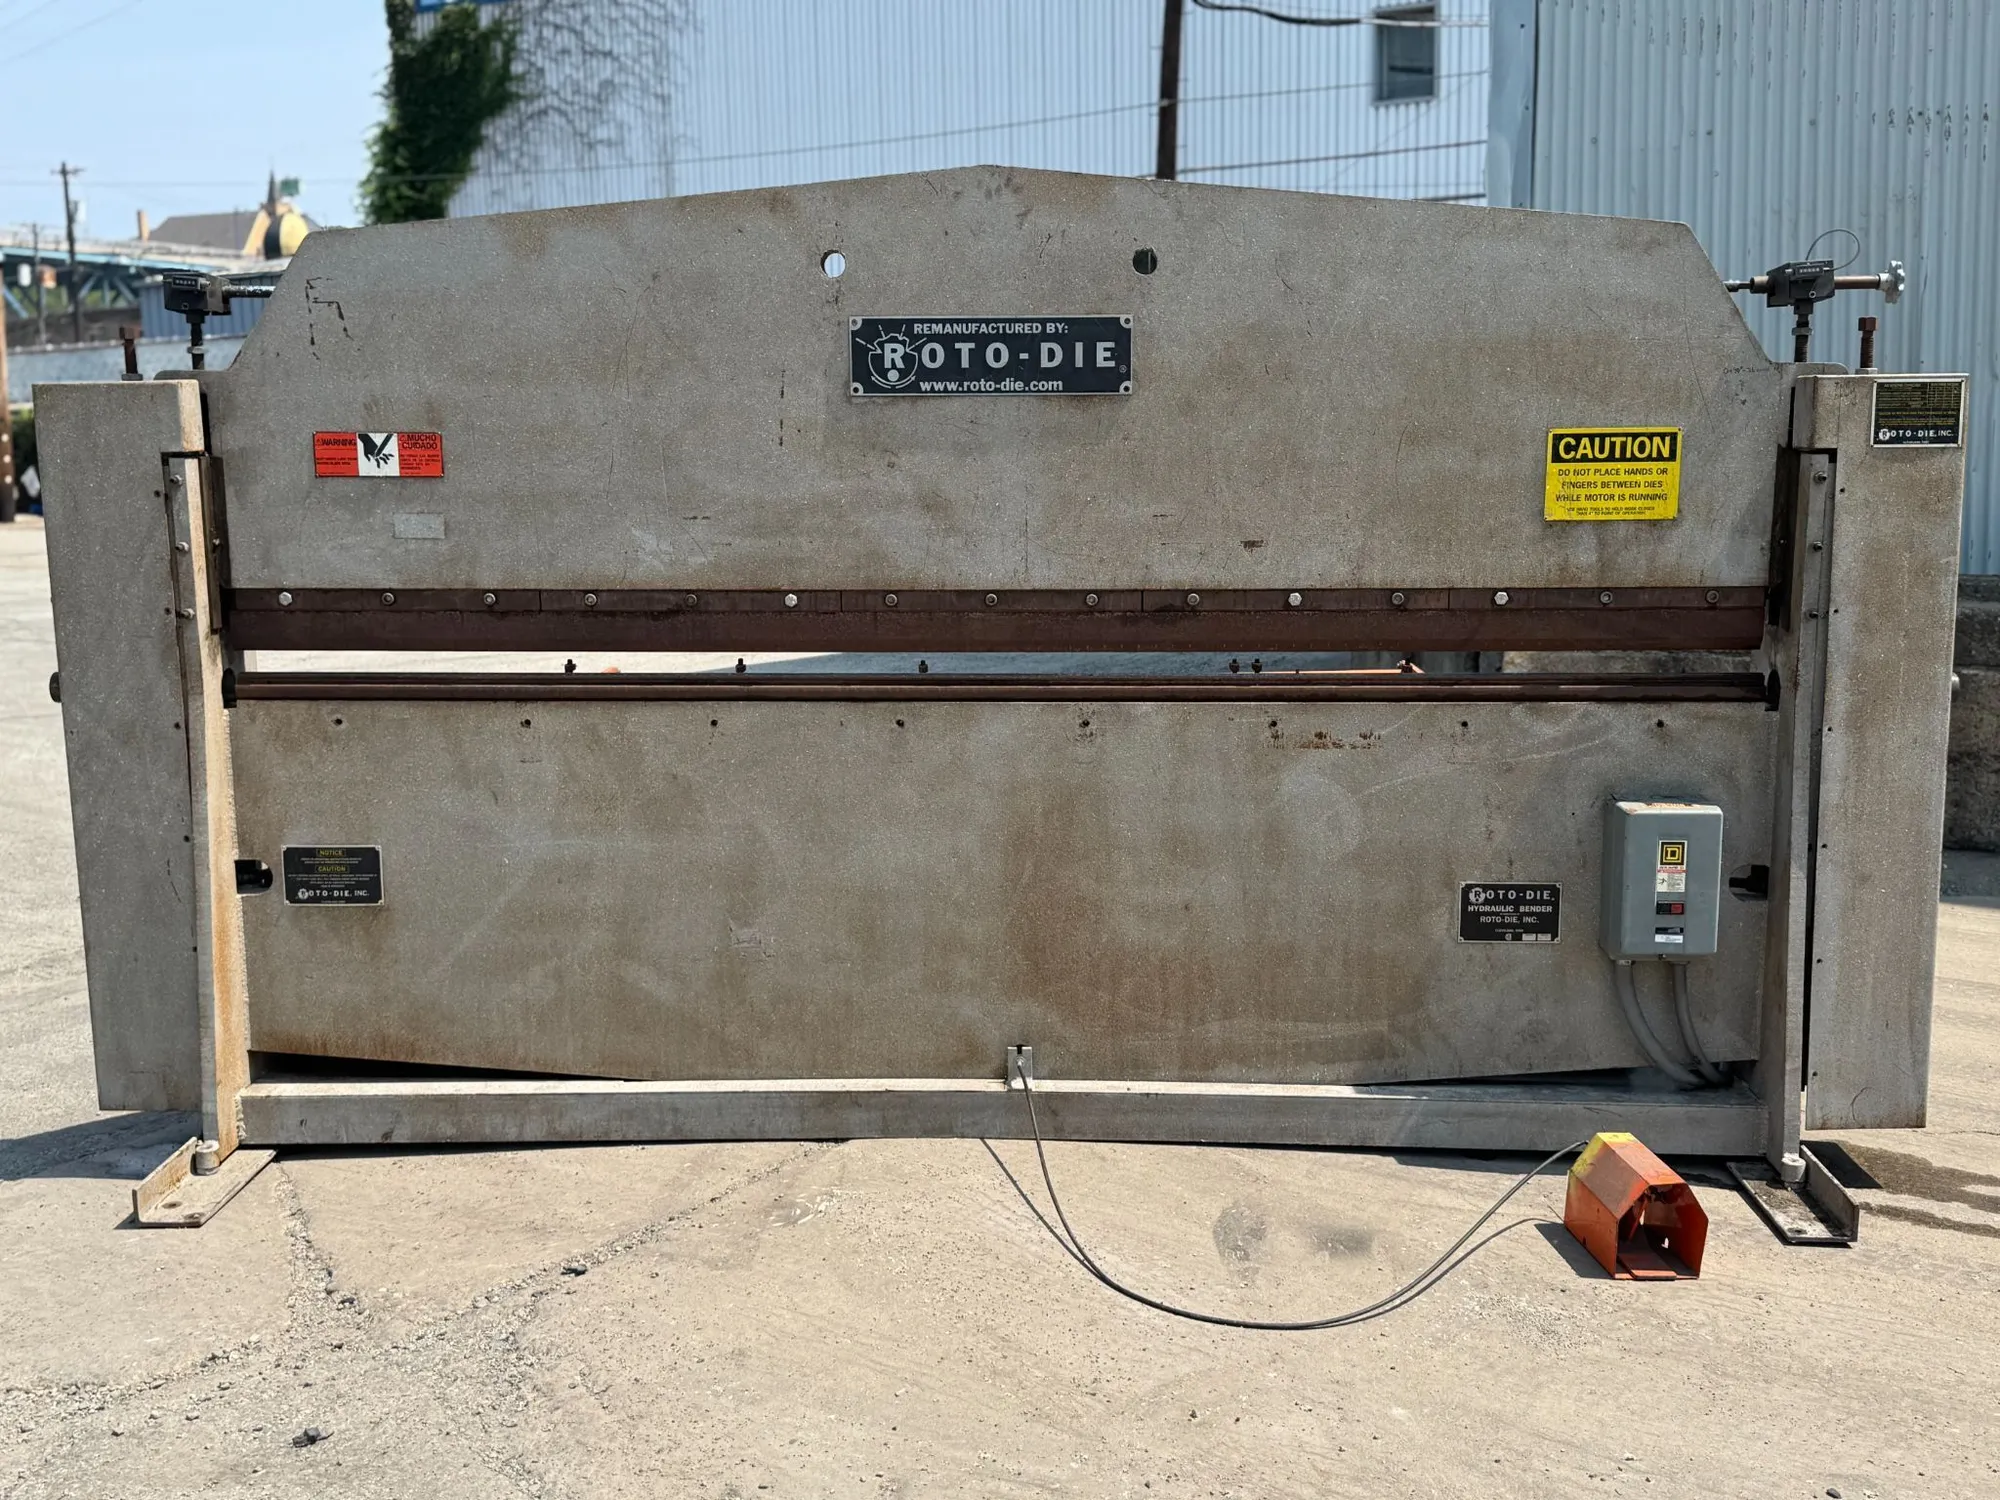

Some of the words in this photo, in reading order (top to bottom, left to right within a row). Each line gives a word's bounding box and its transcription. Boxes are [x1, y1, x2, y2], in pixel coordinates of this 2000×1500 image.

[914, 323, 1042, 334] REMANUFACTURED
[1046, 323, 1069, 334] BY:
[919, 379, 1063, 392] www.roto-die.com
[1559, 436, 1670, 459] CAUTION
[1558, 468, 1571, 477] DO
[1573, 468, 1591, 476] NOT
[1594, 468, 1621, 476] PLACE
[1624, 468, 1653, 476] HANDS
[1656, 467, 1668, 476] OR
[1562, 480, 1598, 489] FINGERS
[1601, 480, 1641, 489] BETWEEN
[1644, 480, 1663, 488] DIES
[1585, 493, 1615, 501] MOTOR
[1618, 493, 1626, 501] IS
[1629, 493, 1668, 501] RUNNING
